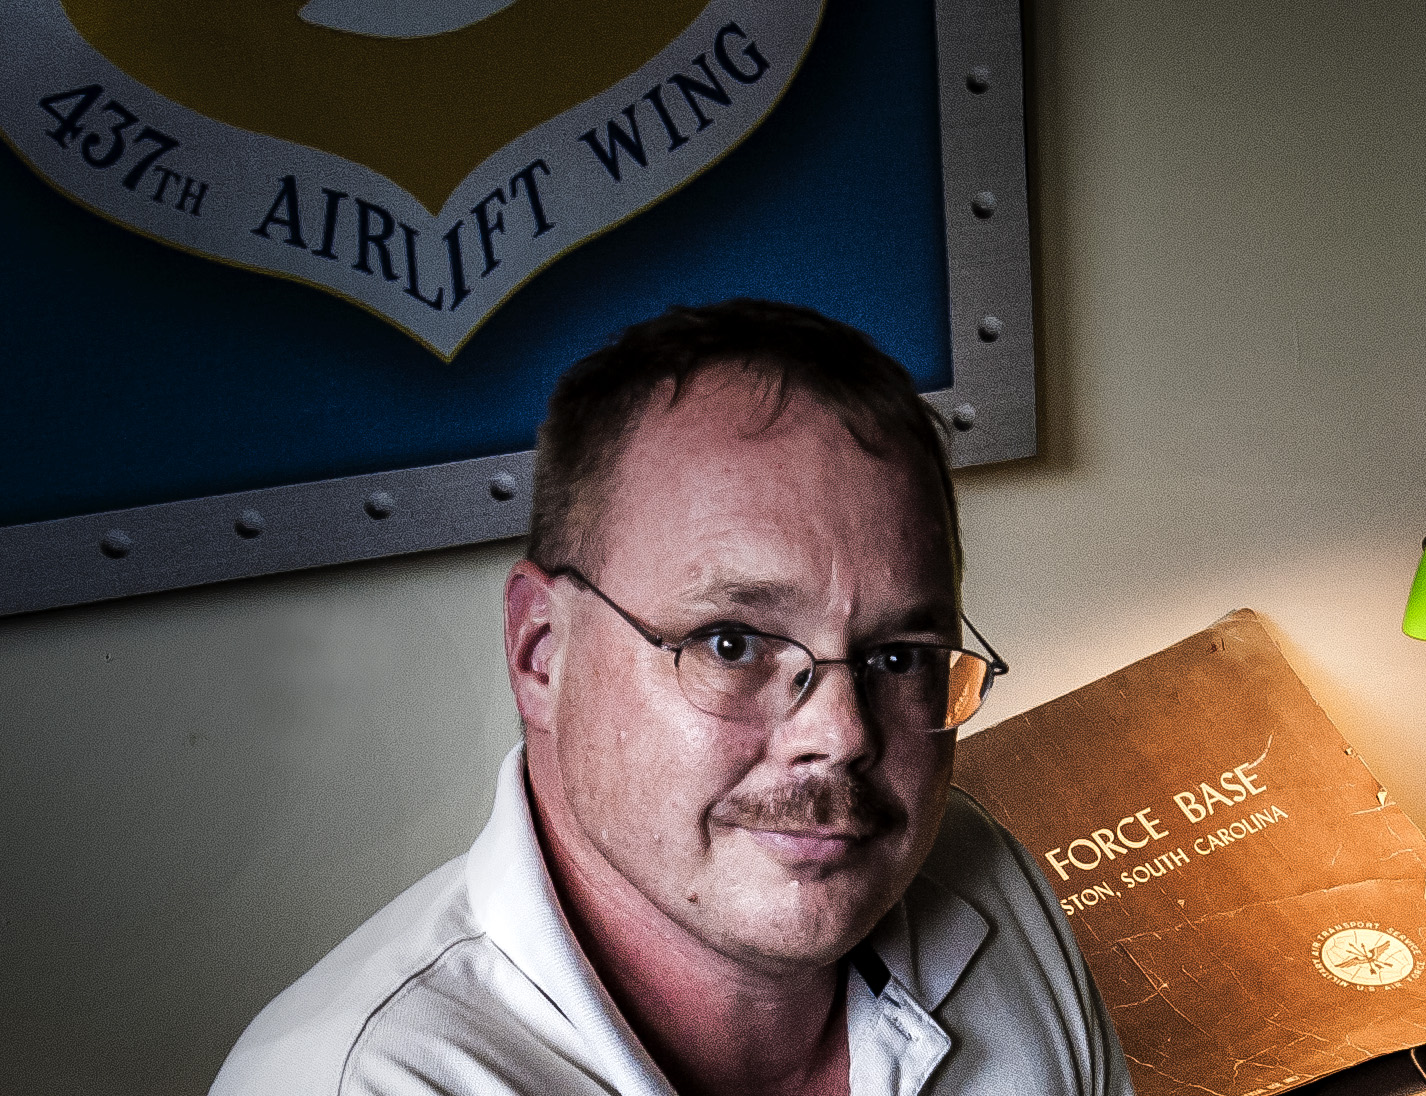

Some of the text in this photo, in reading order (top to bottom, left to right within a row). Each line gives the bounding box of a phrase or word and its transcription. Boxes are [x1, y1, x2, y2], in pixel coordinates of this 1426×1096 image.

[38, 21, 772, 312] 437TH AIRLIFT WING
[1045, 762, 1267, 881] FORCE BASE
[1120, 848, 1190, 888] SOUTH
[1194, 804, 1289, 855] CAROLINA
[1317, 921, 1380, 941] TRANSPORT
[1386, 927, 1423, 957] SERVICE
